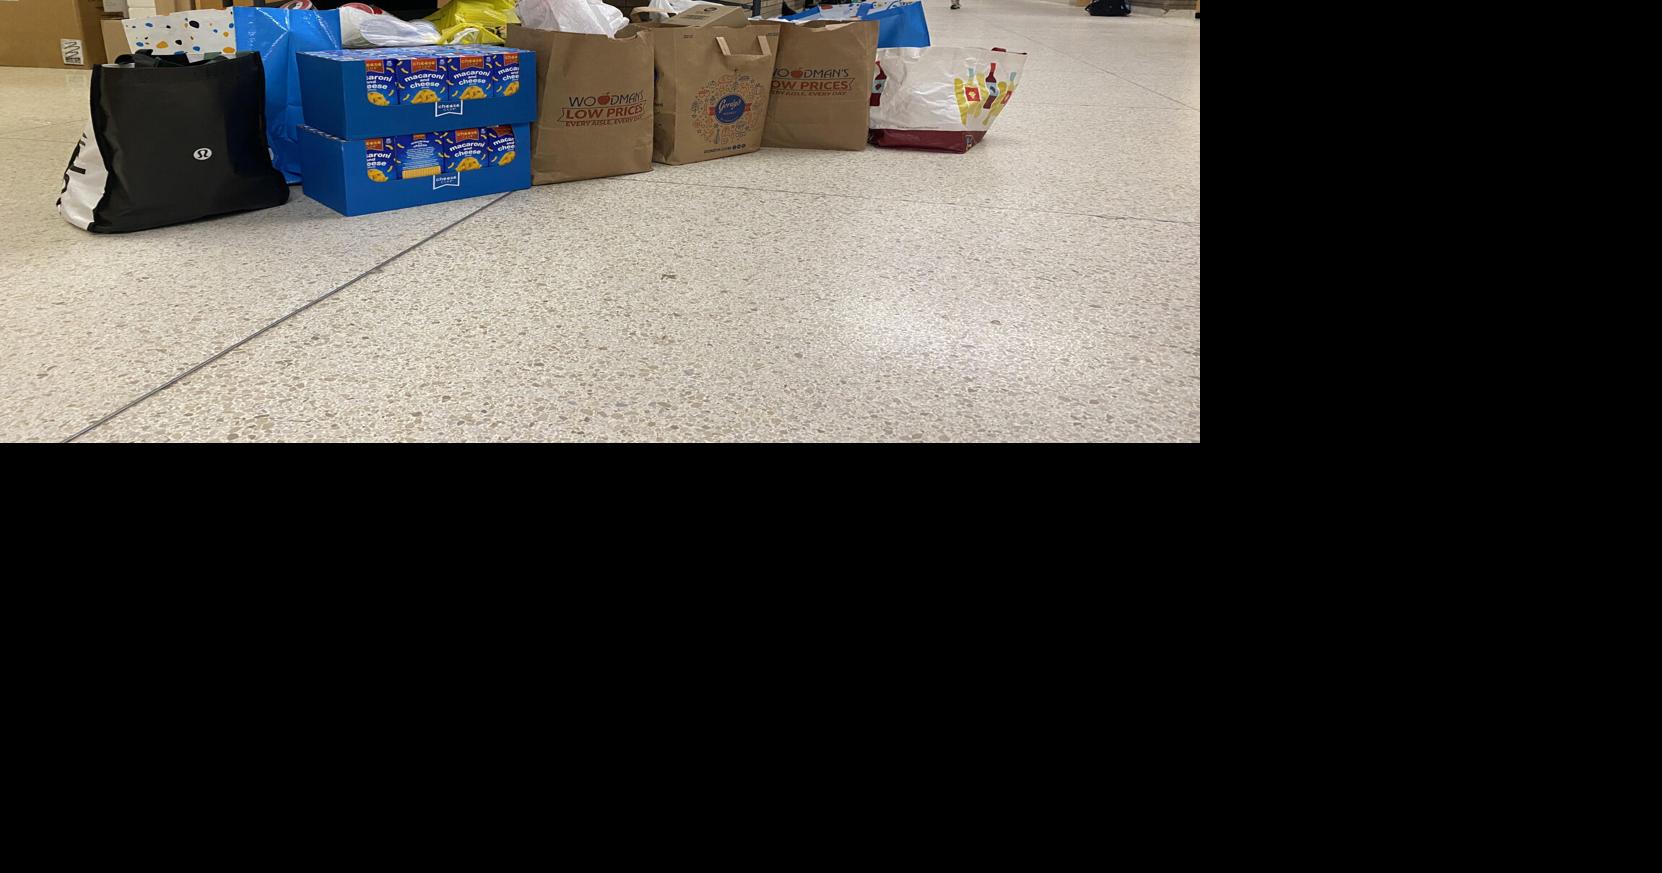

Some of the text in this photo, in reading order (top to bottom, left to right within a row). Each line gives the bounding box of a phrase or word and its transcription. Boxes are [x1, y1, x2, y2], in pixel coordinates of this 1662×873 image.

[453, 70, 491, 79] macaroni
[498, 66, 519, 75] maca
[404, 73, 445, 82] macaroni
[771, 80, 848, 90] OW PRICES
[566, 103, 643, 120] LOW PRICES
[493, 137, 514, 146] macar
[449, 142, 485, 151] macaroni
[497, 144, 515, 152] chee
[454, 150, 481, 158] cheese
